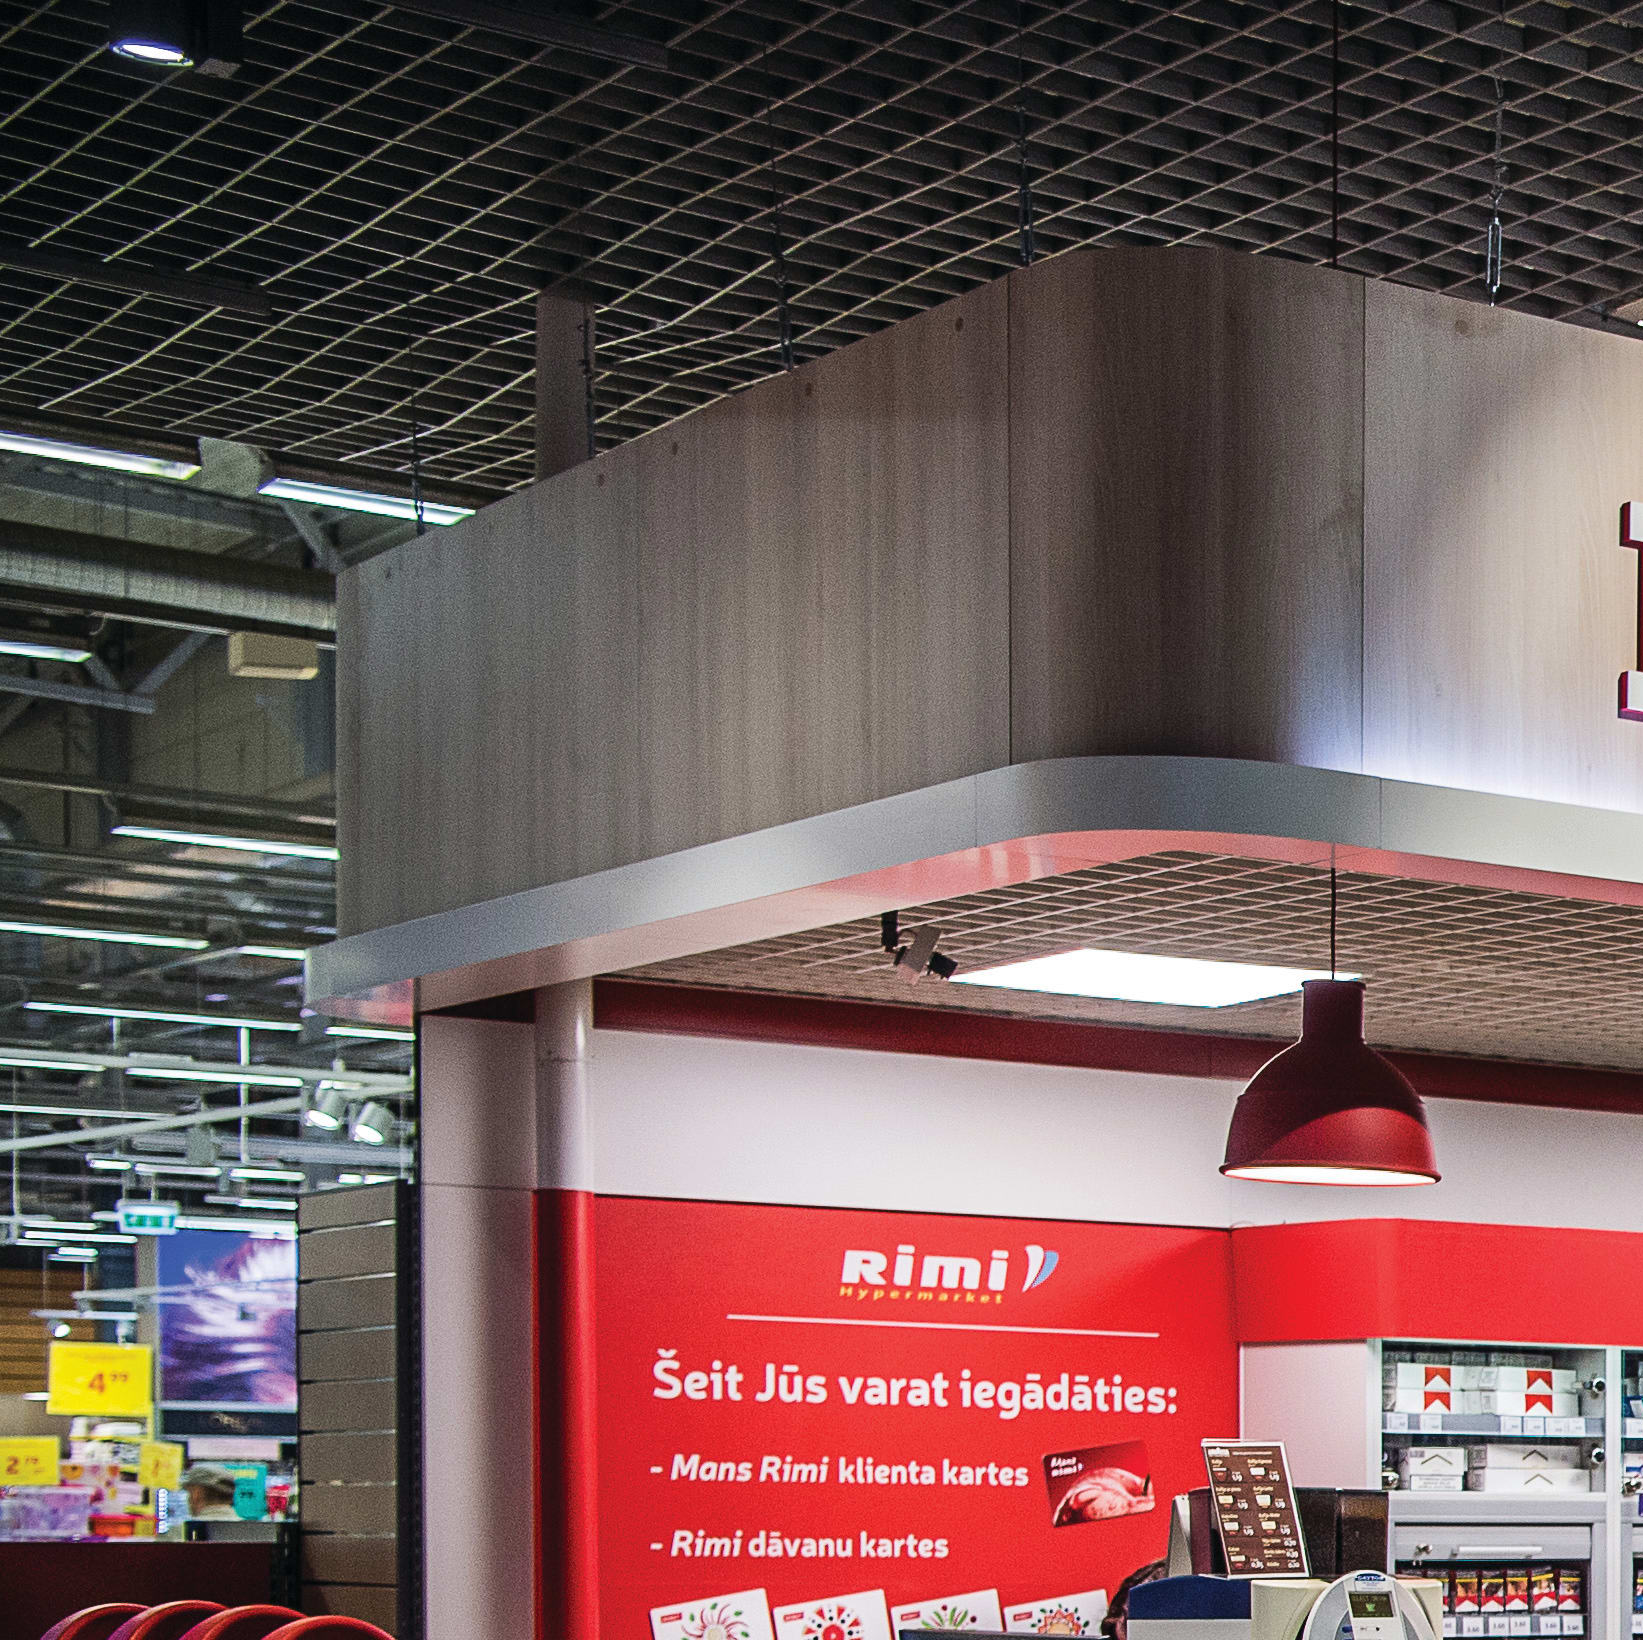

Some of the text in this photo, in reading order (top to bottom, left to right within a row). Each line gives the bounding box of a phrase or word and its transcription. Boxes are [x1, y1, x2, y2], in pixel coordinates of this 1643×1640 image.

[840, 1244, 1009, 1290] Rimi
[839, 1286, 1003, 1304] Hypermarket
[653, 1348, 1178, 1420] Šeit Jūs varat iegādāties:
[670, 1454, 753, 1484] Mans
[759, 1455, 828, 1484] Rimi
[838, 1456, 936, 1485] klienta
[942, 1459, 1029, 1487] kartes
[670, 1530, 743, 1558] Rimi
[748, 1531, 853, 1558] dāvanu
[860, 1533, 949, 1559] kartes
